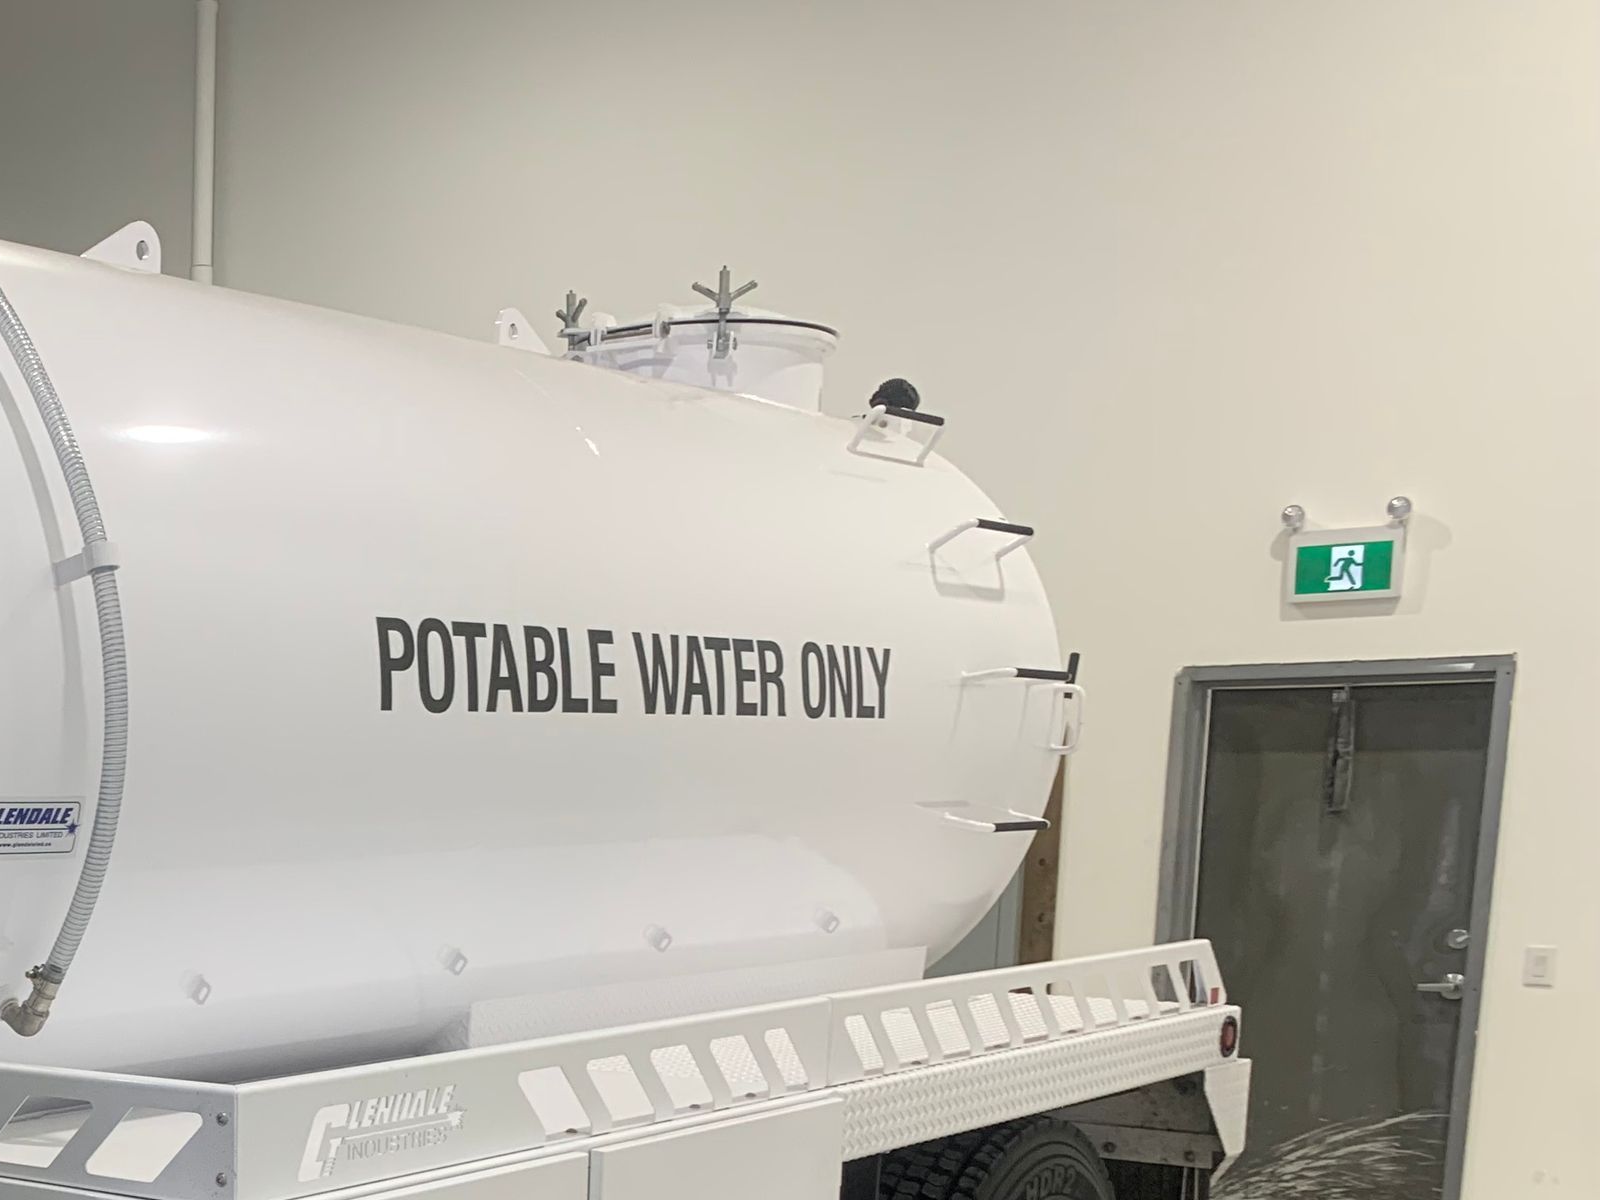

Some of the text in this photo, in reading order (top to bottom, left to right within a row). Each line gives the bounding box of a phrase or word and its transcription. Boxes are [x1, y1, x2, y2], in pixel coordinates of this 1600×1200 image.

[375, 616, 891, 719] POTABLE WATER ONLY
